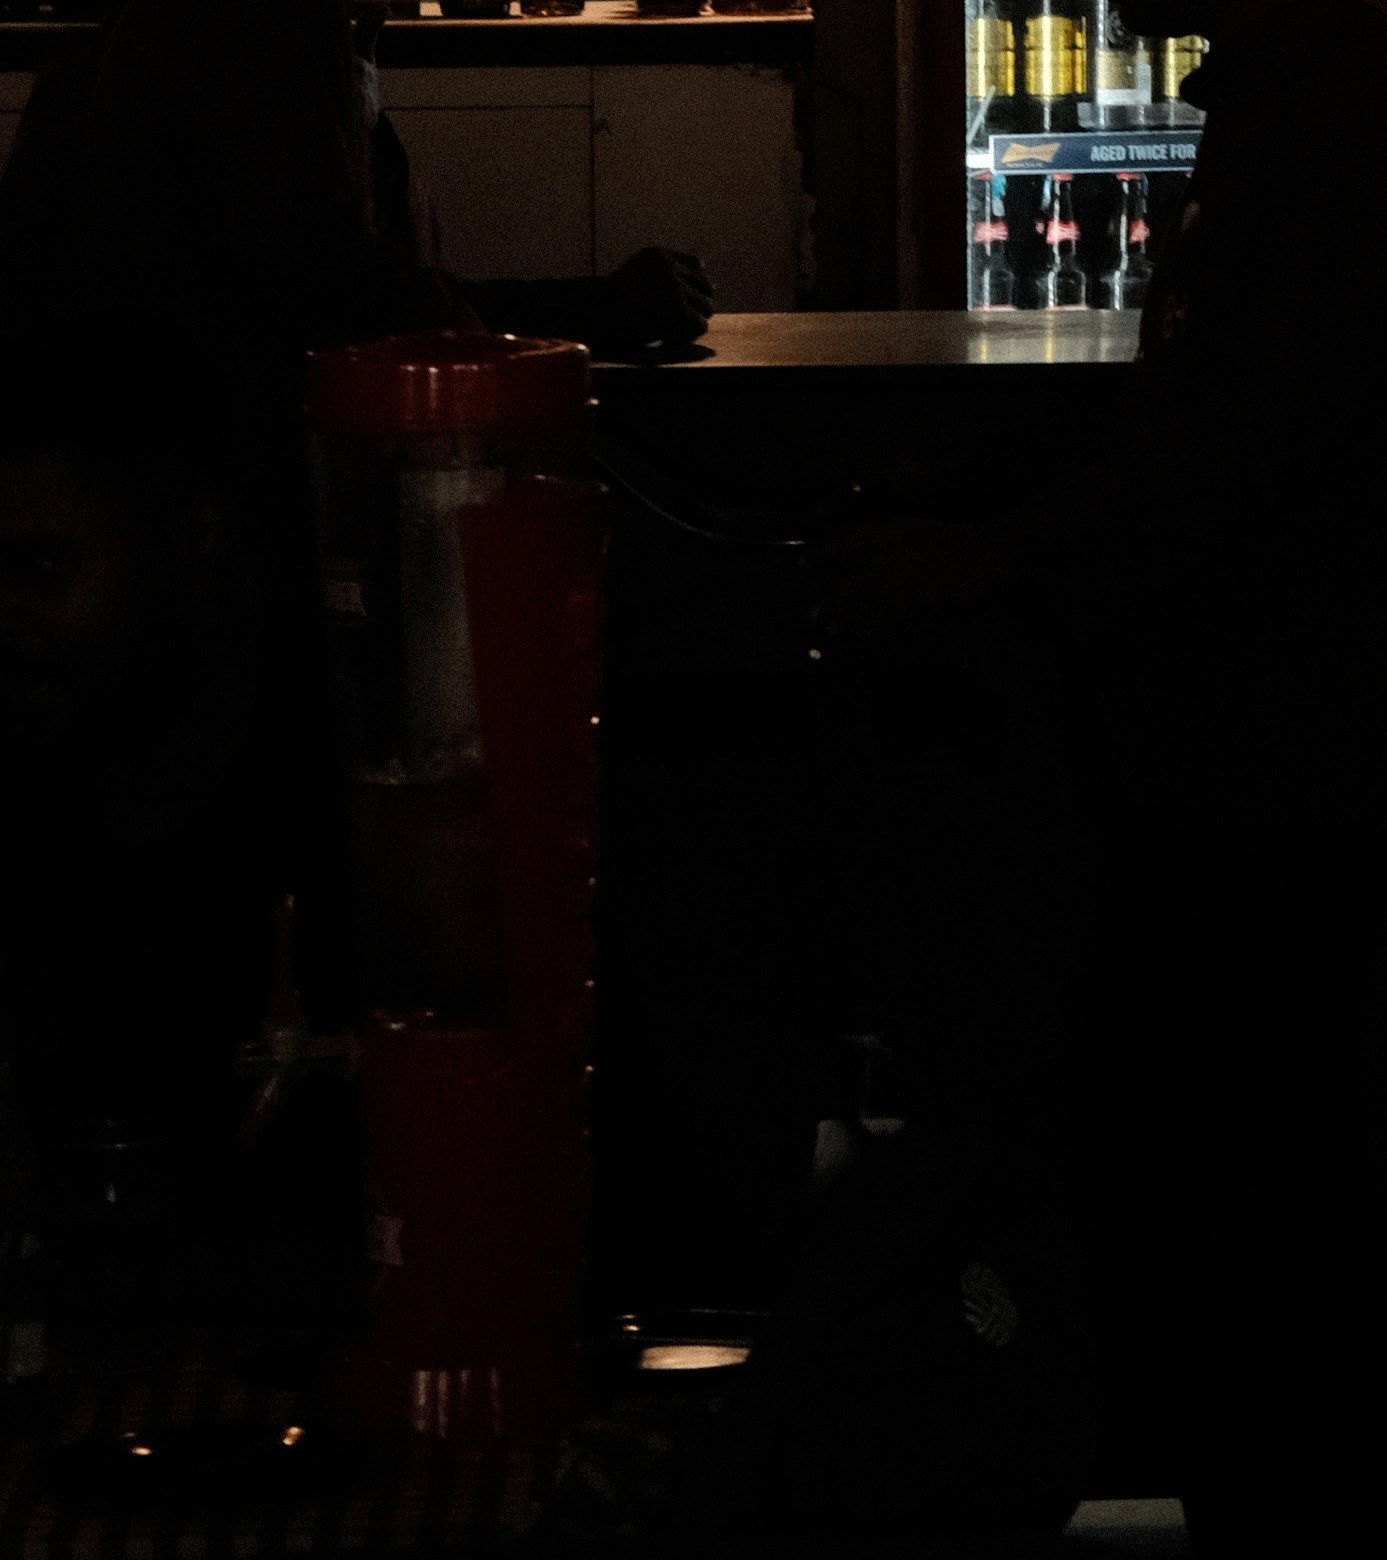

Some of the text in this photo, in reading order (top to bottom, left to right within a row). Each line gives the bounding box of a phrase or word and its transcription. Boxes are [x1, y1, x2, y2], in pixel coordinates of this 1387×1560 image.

[1090, 143, 1197, 161] AGED TWICE FOR
